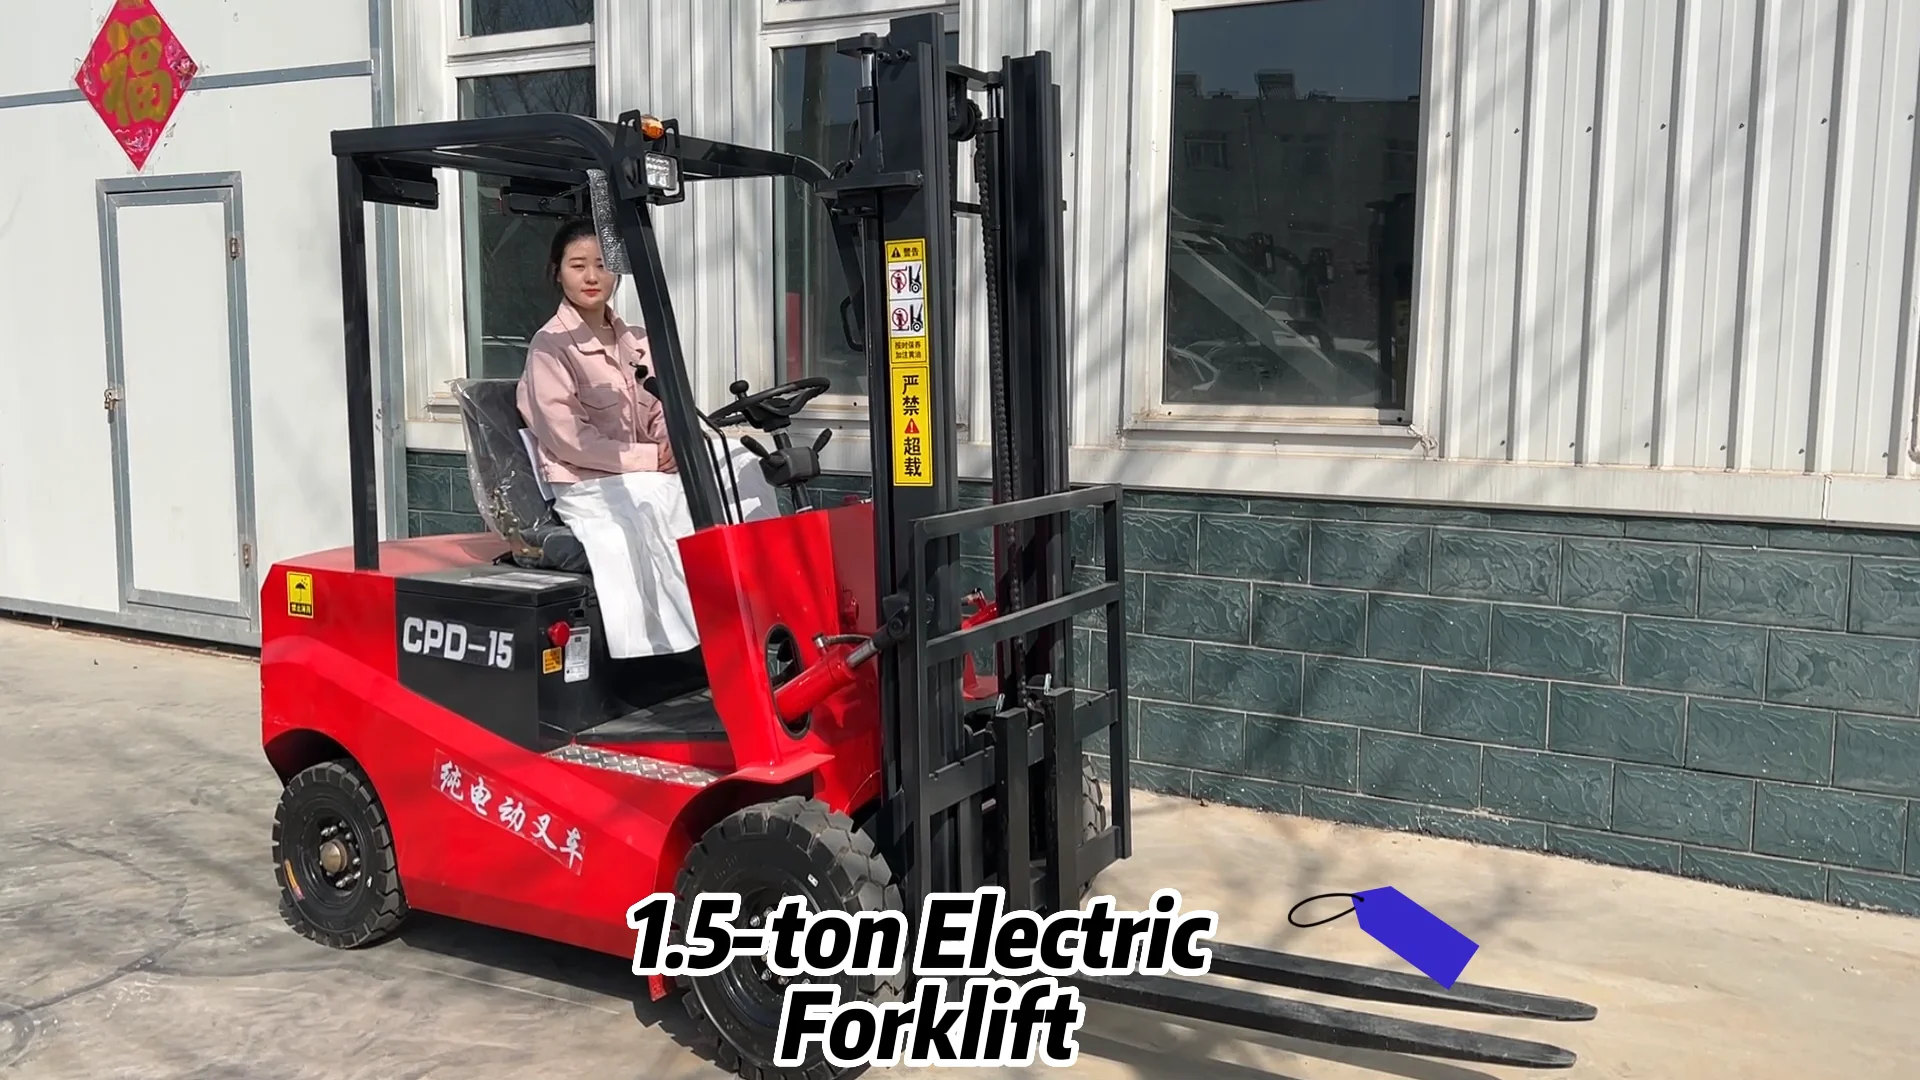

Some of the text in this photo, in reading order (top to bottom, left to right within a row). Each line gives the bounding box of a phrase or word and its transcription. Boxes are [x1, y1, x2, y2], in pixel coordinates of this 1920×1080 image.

[100, 14, 173, 127] 福
[901, 374, 923, 477] 严禁超载
[402, 616, 515, 669] CPD-15
[439, 759, 584, 869] 纯电动叉车
